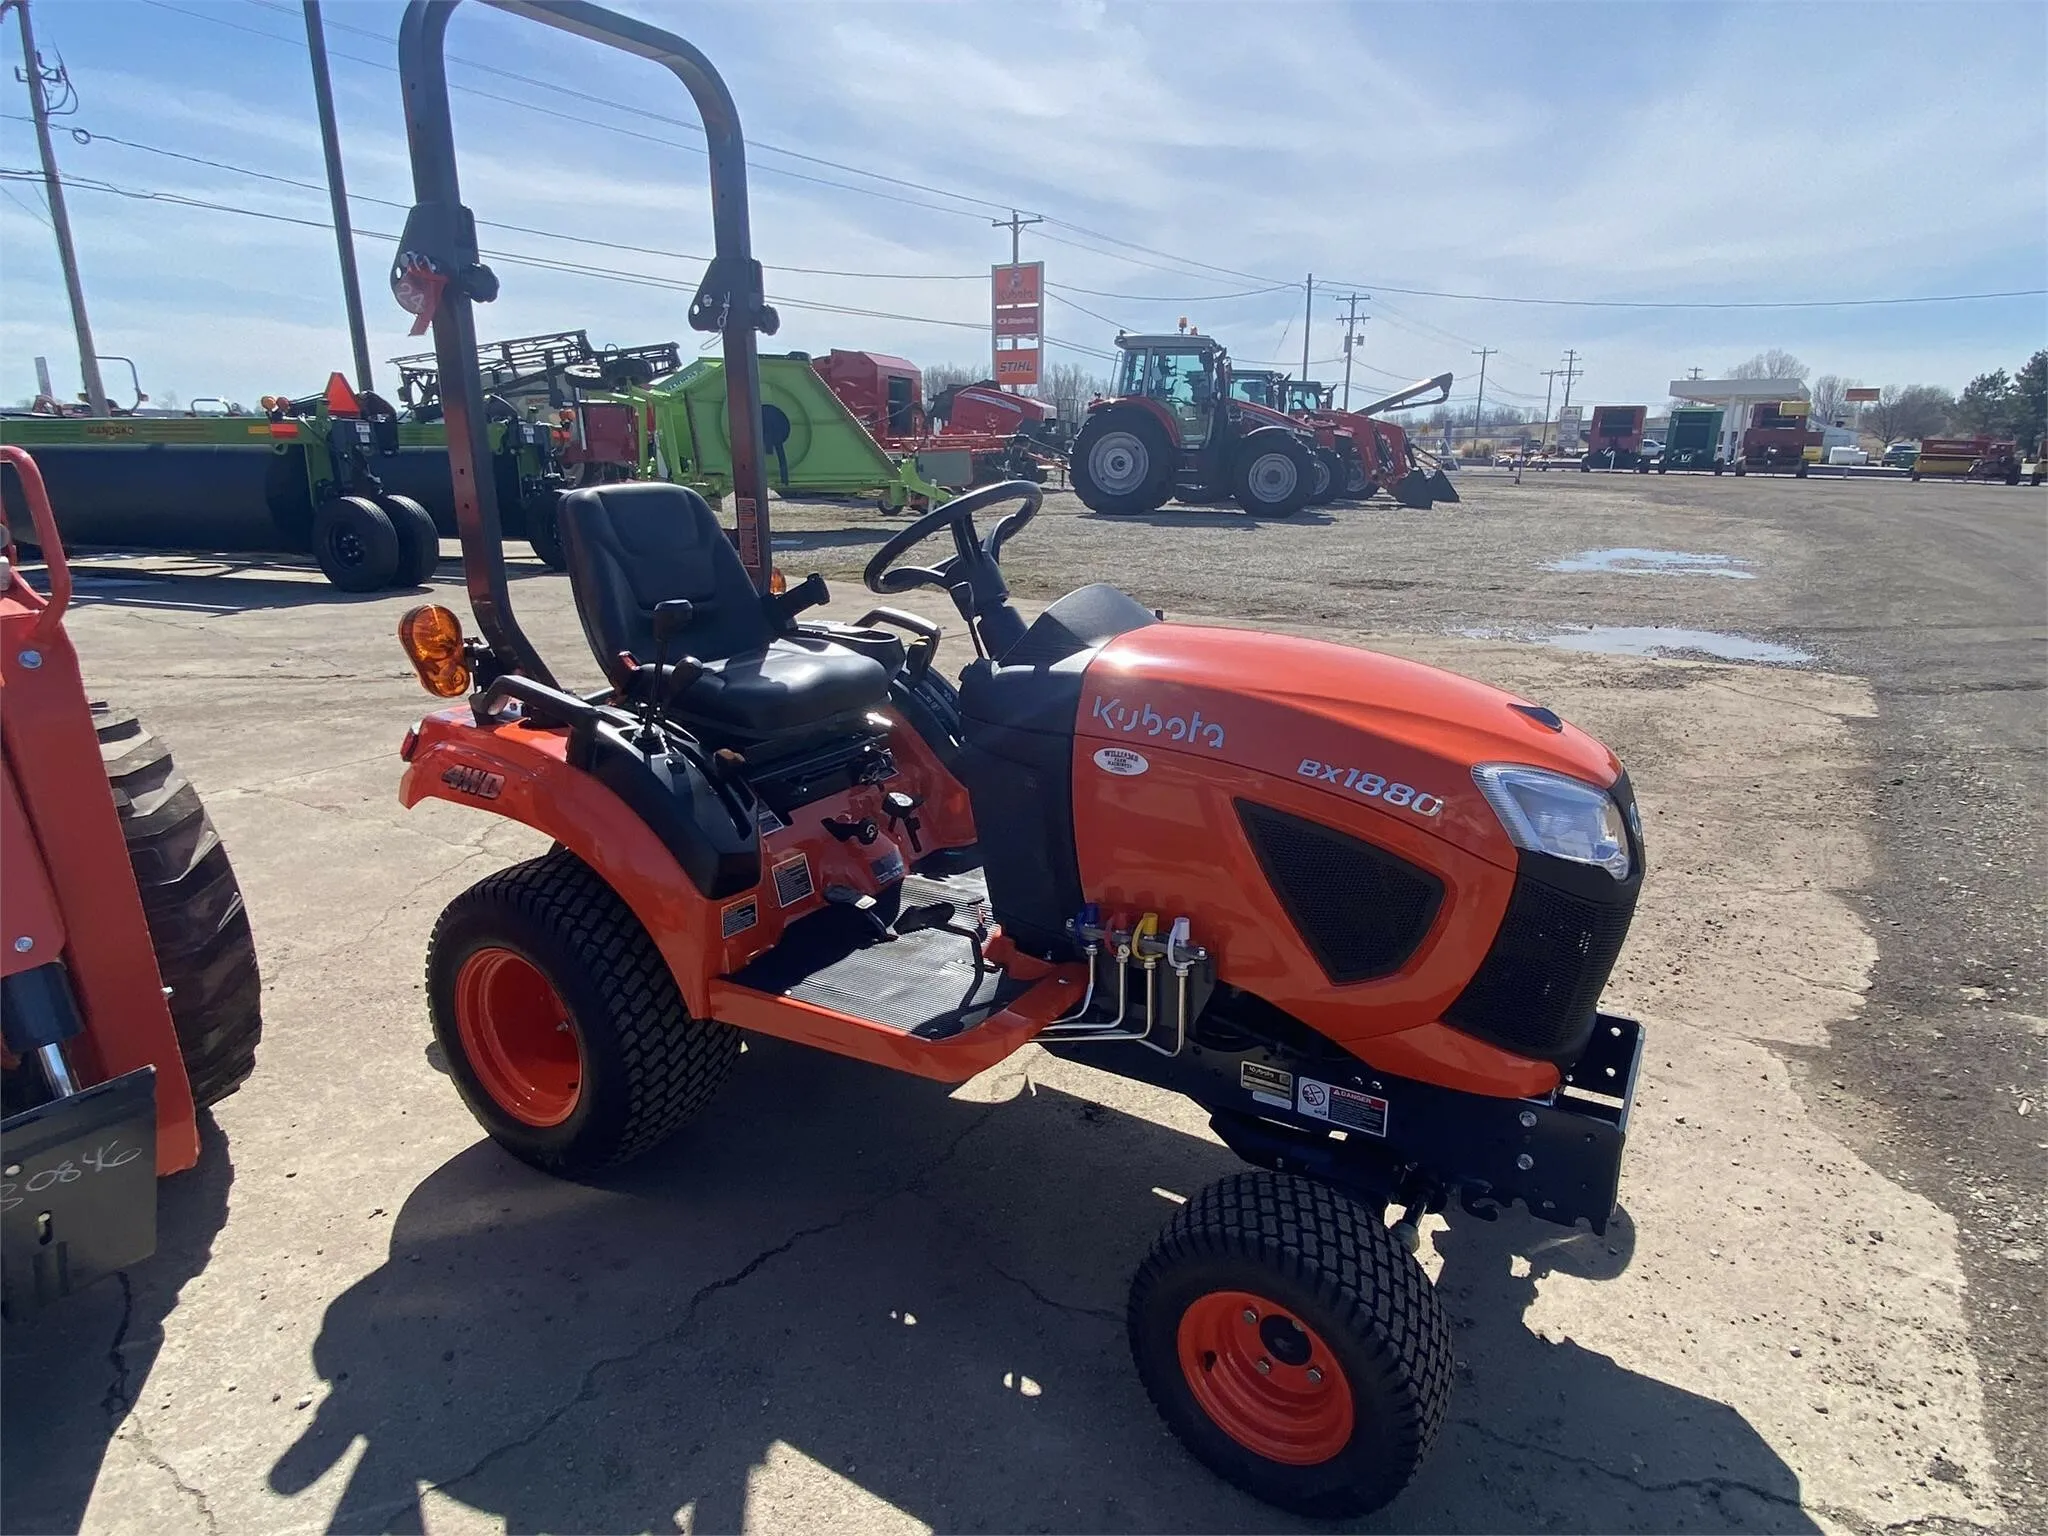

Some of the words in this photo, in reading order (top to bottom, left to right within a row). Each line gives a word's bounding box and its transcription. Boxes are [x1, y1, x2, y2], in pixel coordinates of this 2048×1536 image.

[999, 361, 1033, 372] STIHL
[1092, 695, 1225, 749] Kubota
[441, 764, 505, 799] 4WD
[1296, 758, 1444, 817] BX1880
[1340, 1090, 1372, 1104] DANGER
